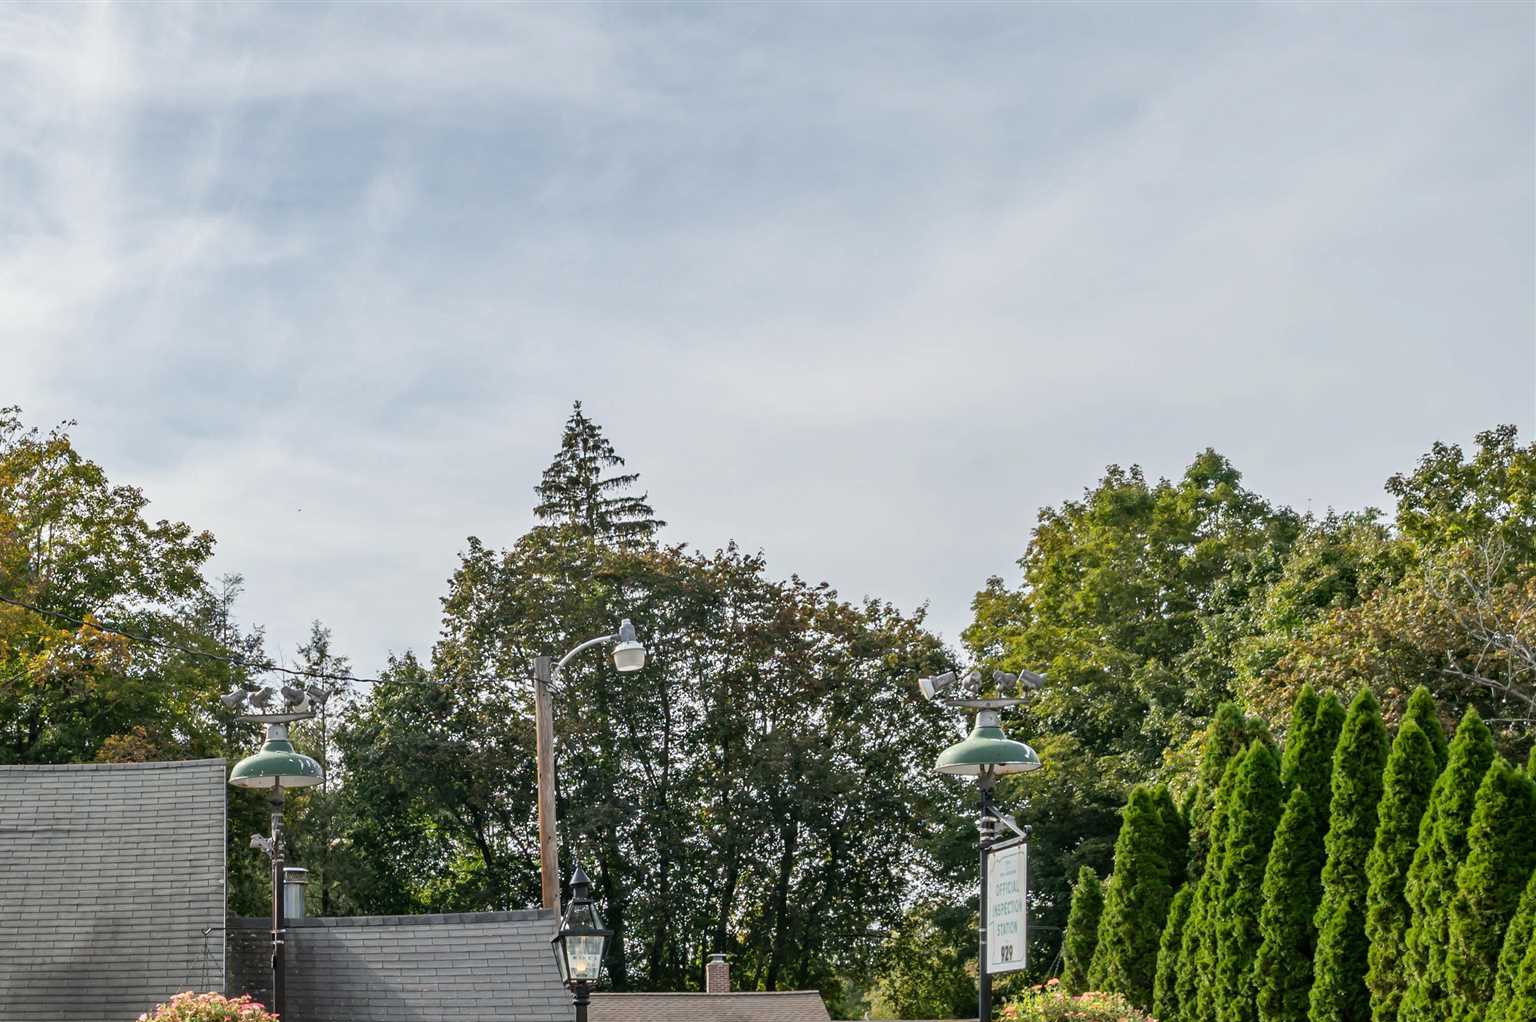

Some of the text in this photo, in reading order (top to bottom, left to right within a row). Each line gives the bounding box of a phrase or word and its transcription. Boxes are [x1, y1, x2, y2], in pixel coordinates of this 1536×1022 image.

[996, 880, 1019, 896] OFFICIAL
[992, 899, 1023, 917] INSPECTION
[997, 921, 1018, 936] STATION
[1001, 945, 1013, 962] 929
